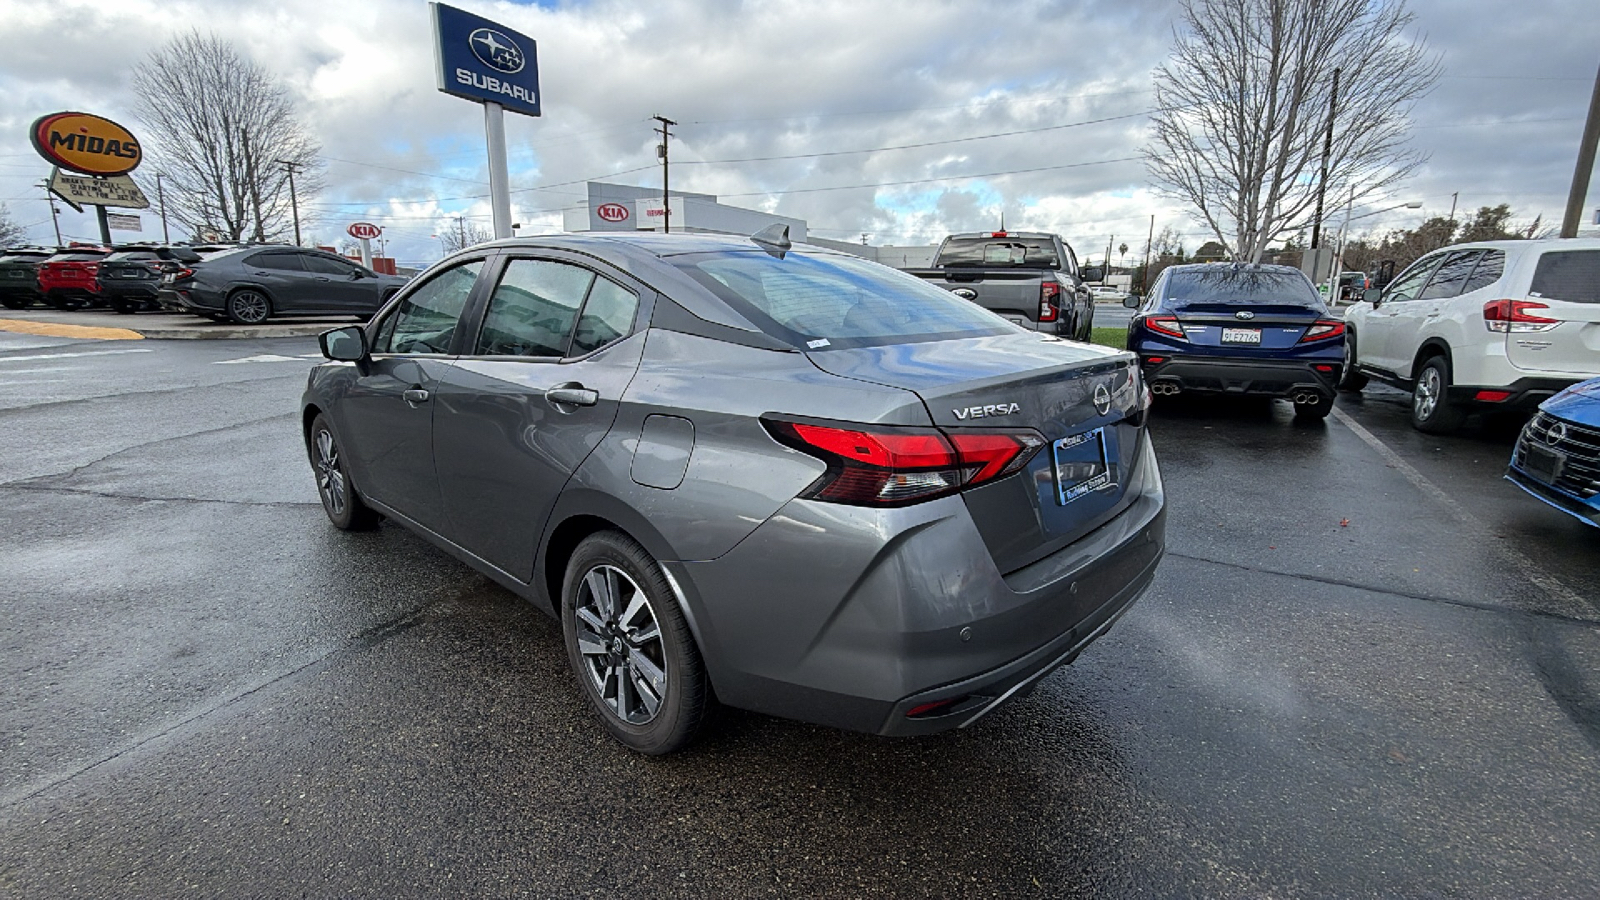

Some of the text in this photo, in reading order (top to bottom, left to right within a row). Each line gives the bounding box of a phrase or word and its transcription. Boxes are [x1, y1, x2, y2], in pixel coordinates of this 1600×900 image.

[456, 68, 535, 104] SUBARU
[51, 126, 138, 158] MIDAS
[603, 206, 624, 219] KIA
[354, 225, 376, 236] KIA
[952, 403, 1020, 420] VERSA
